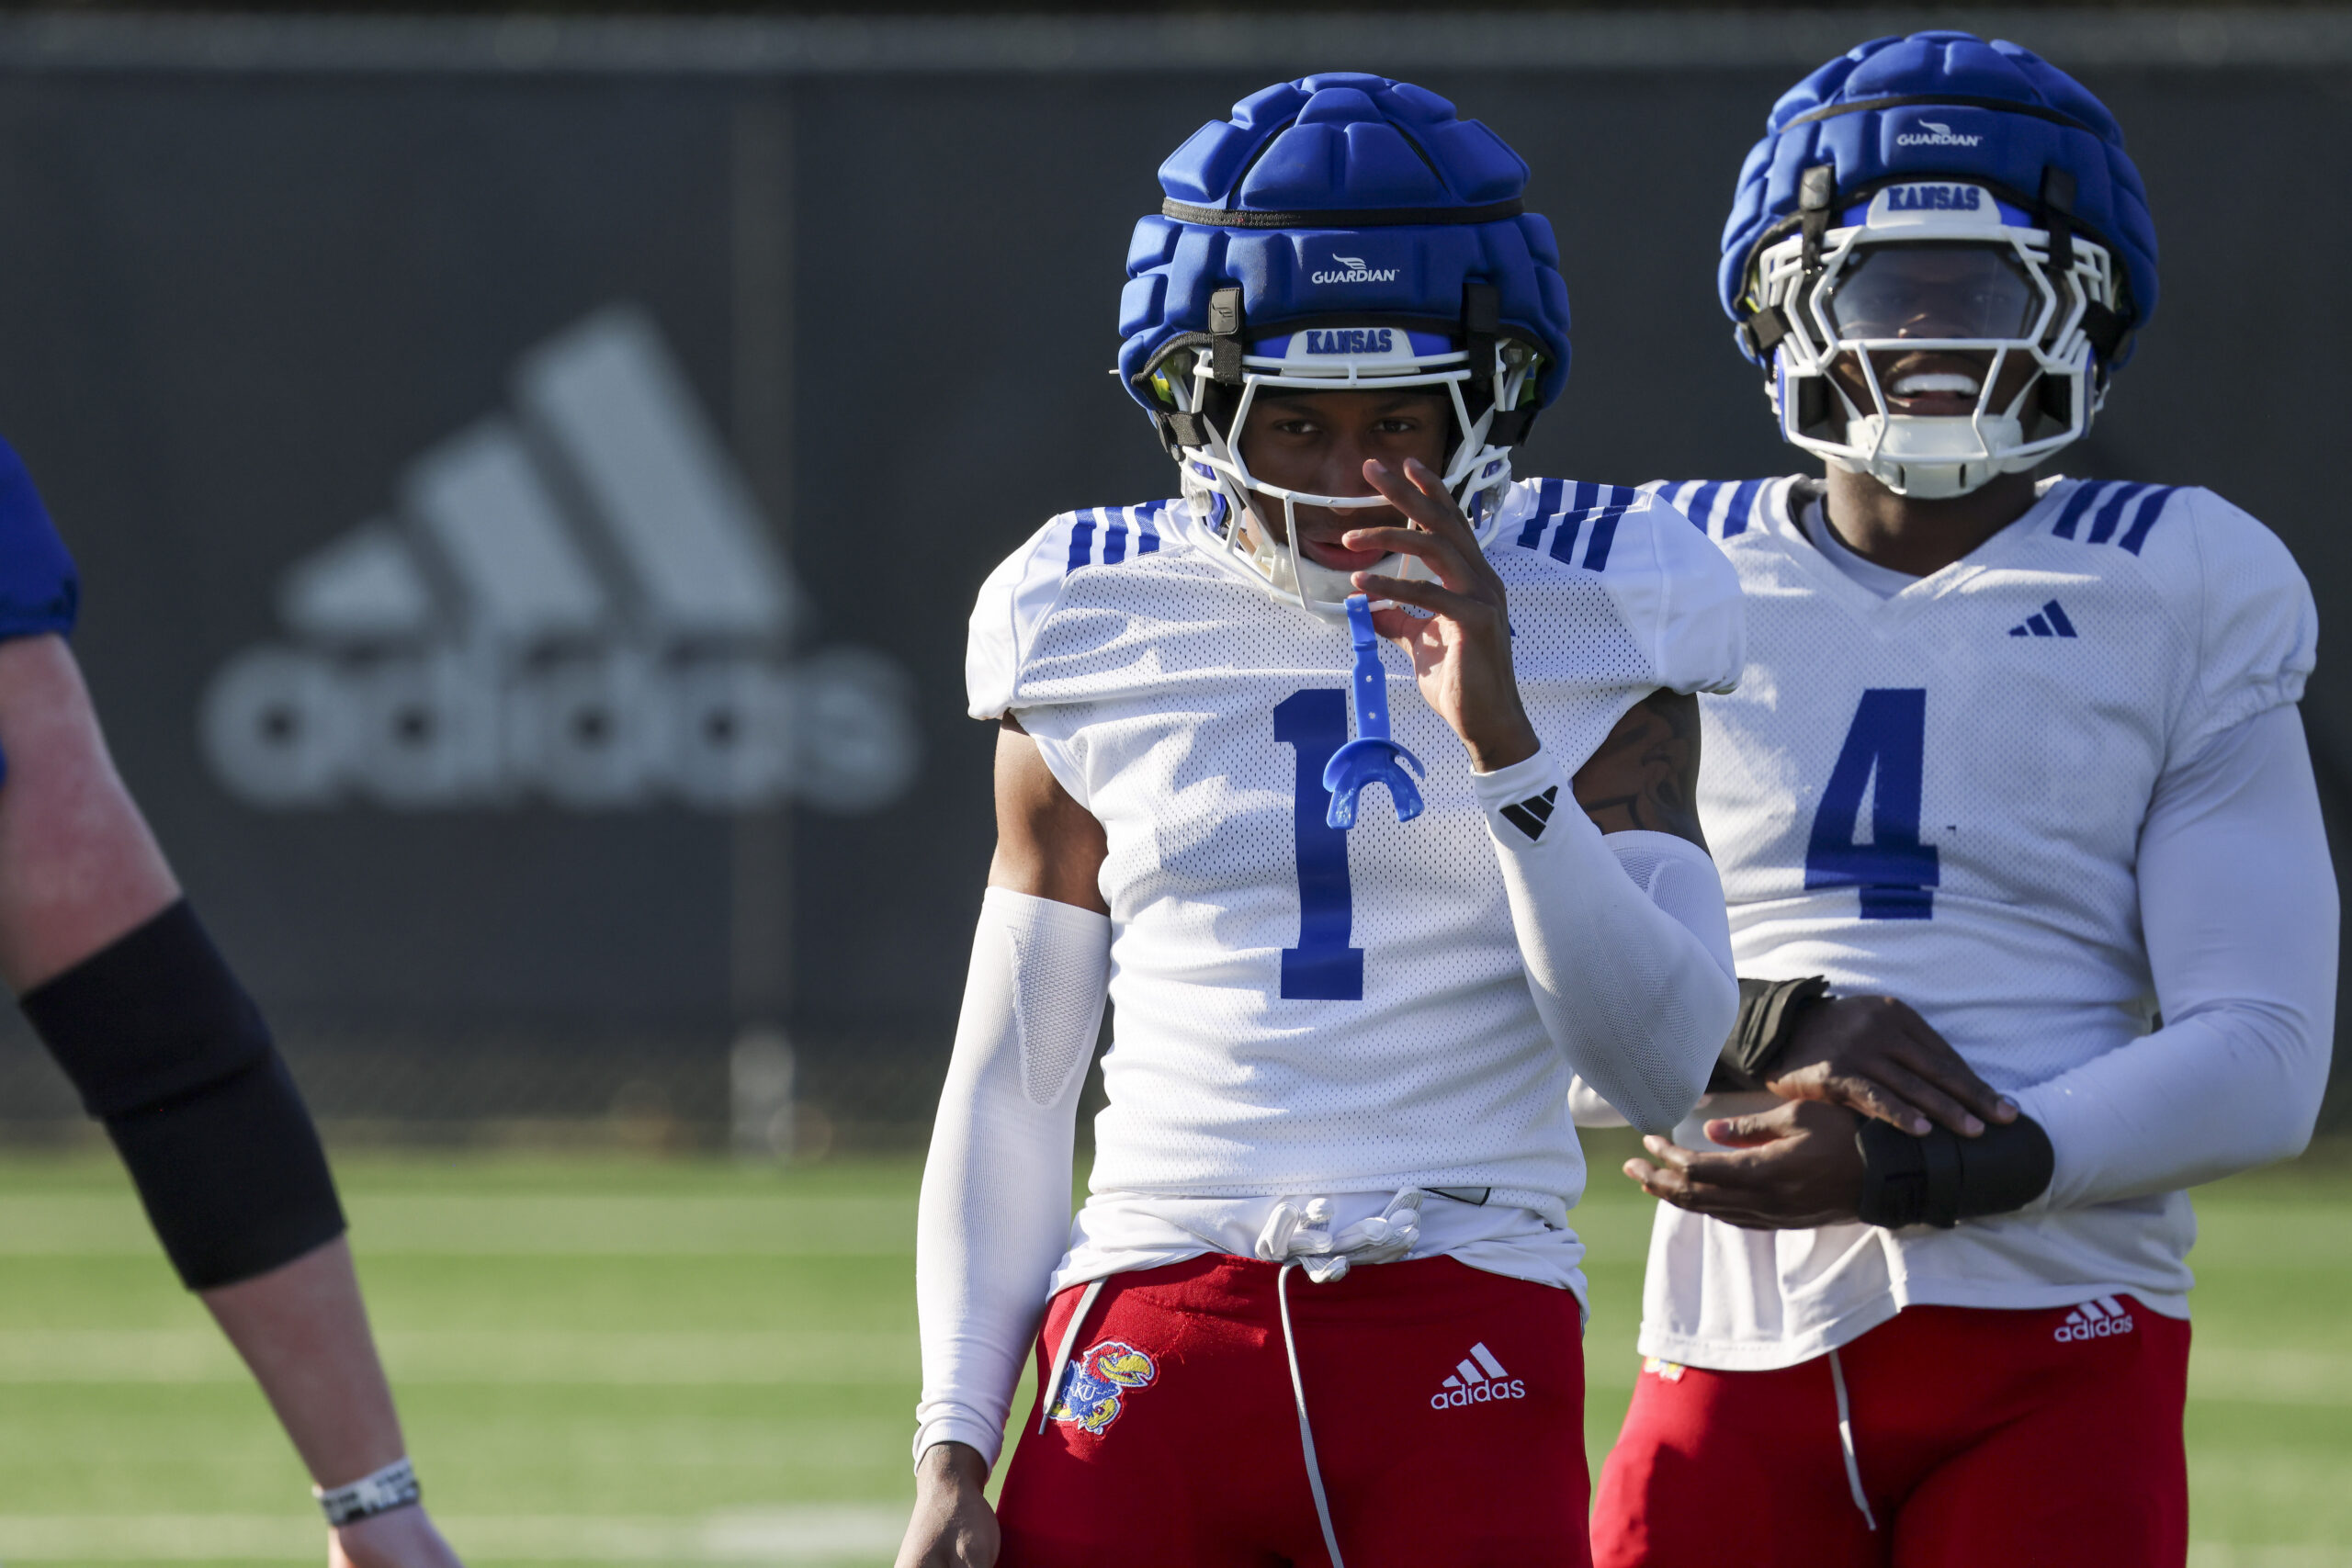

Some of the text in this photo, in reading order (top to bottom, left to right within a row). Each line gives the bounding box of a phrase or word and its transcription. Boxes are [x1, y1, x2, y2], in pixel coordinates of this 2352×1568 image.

[1896, 133, 1979, 147] GUARDIAN
[1887, 186, 1980, 211] KANSAS
[1311, 269, 1396, 284] GUARDIAN
[1306, 329, 1392, 355] KANSAS
[198, 636, 915, 812] adidas
[1804, 688, 1939, 920] 4
[1273, 688, 1364, 1001] 1
[2053, 1314, 2133, 1343] adidas
[1072, 1382, 1097, 1402] KU
[1430, 1378, 1526, 1410] adidas
